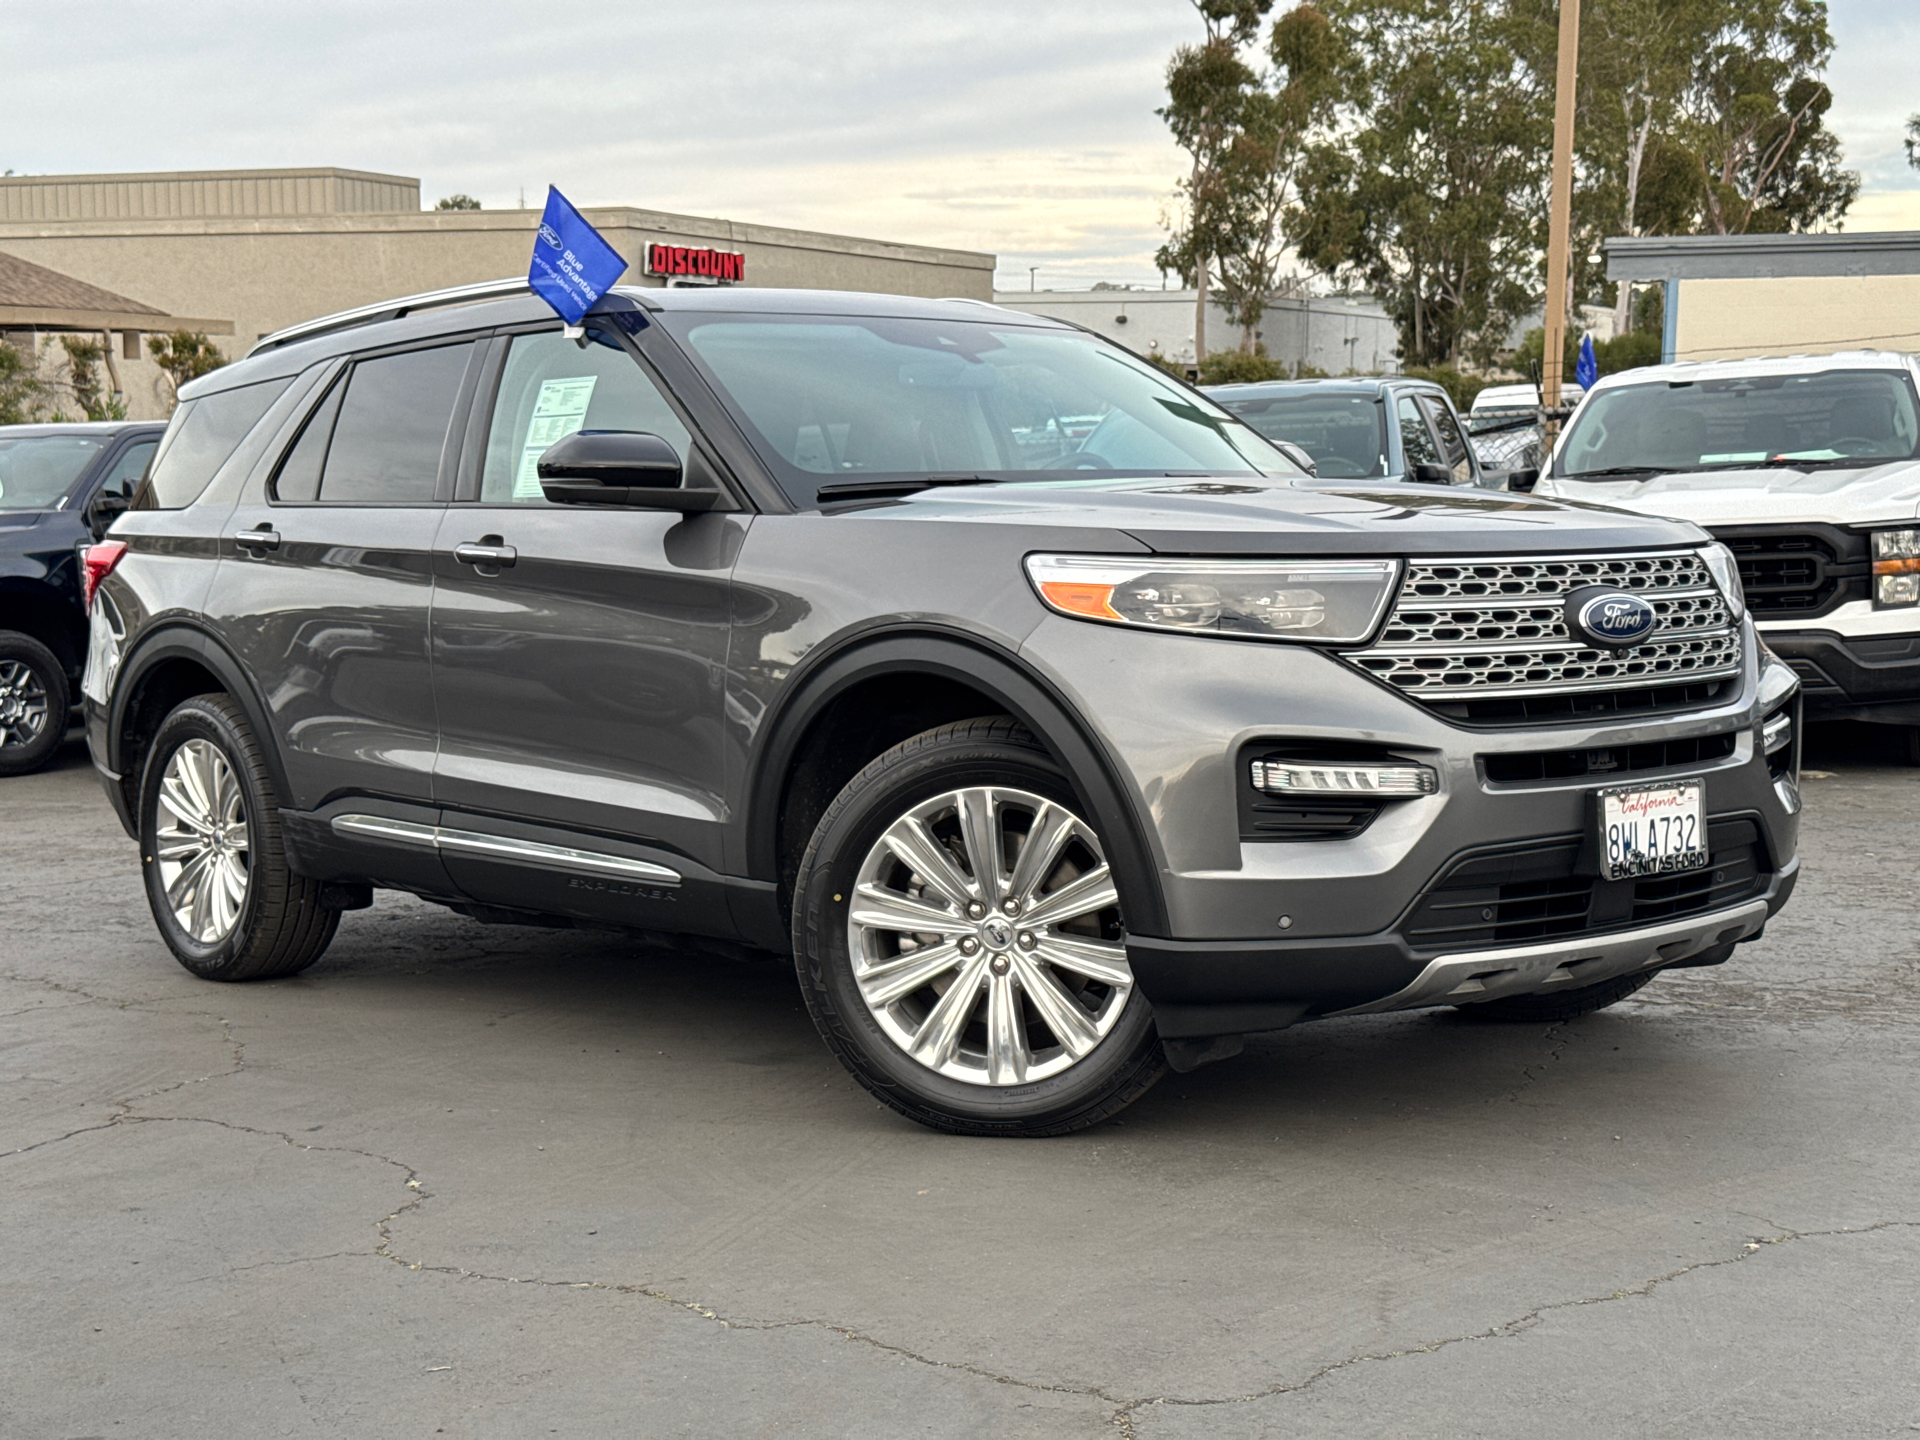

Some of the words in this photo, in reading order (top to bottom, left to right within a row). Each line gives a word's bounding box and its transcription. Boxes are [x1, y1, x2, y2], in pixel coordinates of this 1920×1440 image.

[533, 253, 559, 279] Certified
[555, 276, 572, 294] Used
[562, 249, 584, 272] Blue
[650, 244, 744, 281] DISCOUNT
[556, 258, 598, 302] Advantage
[1602, 603, 1643, 630] Ford
[1621, 792, 1684, 817] California
[1611, 857, 1675, 879] ENCINITAS
[1674, 852, 1704, 872] FORD
[567, 879, 677, 901] EXPLORER
